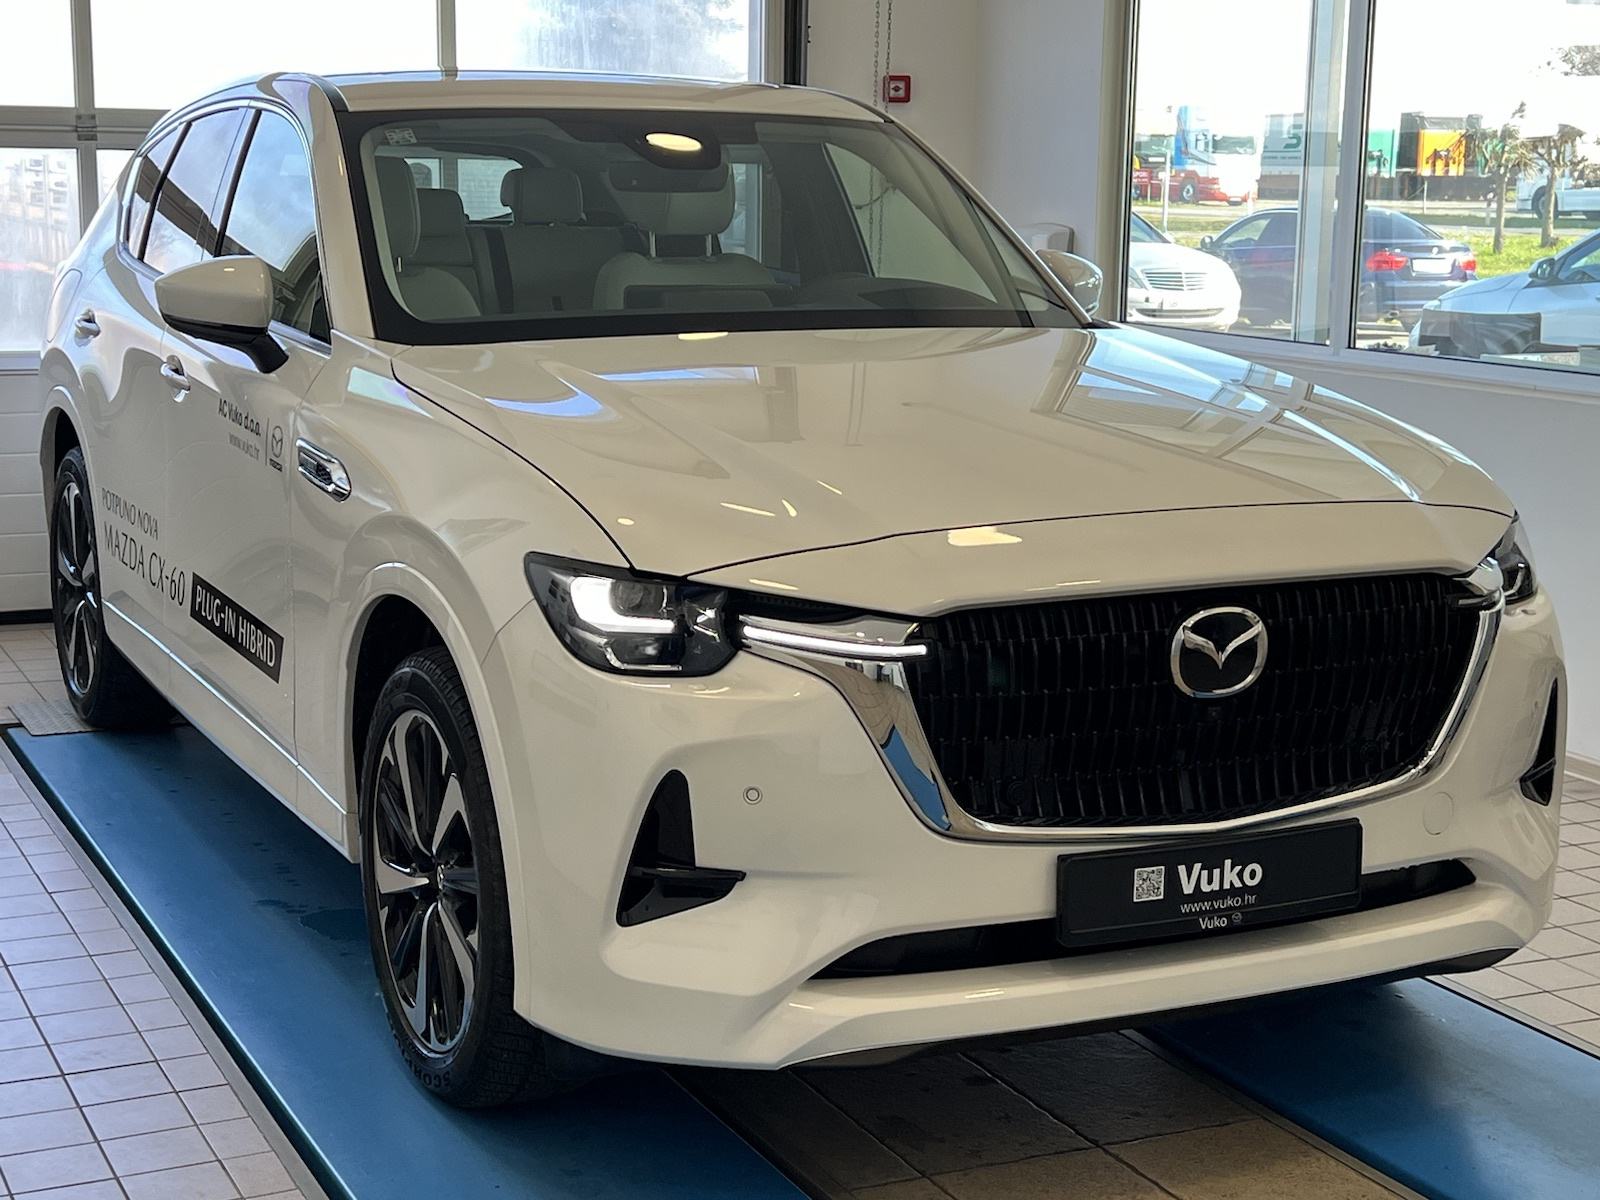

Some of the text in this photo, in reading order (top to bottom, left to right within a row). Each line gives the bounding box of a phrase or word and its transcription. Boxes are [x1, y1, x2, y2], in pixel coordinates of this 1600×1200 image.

[219, 398, 227, 418] AC
[228, 401, 243, 426] Vuko
[102, 487, 159, 540] POTPUNO NOVA
[104, 521, 185, 606] MAZDA CX-60
[196, 585, 276, 668] PLUG-IN HIBRID
[1177, 859, 1263, 894] Vuko
[1180, 893, 1257, 913] www.vuko.hr
[1199, 916, 1228, 929] Vuko
